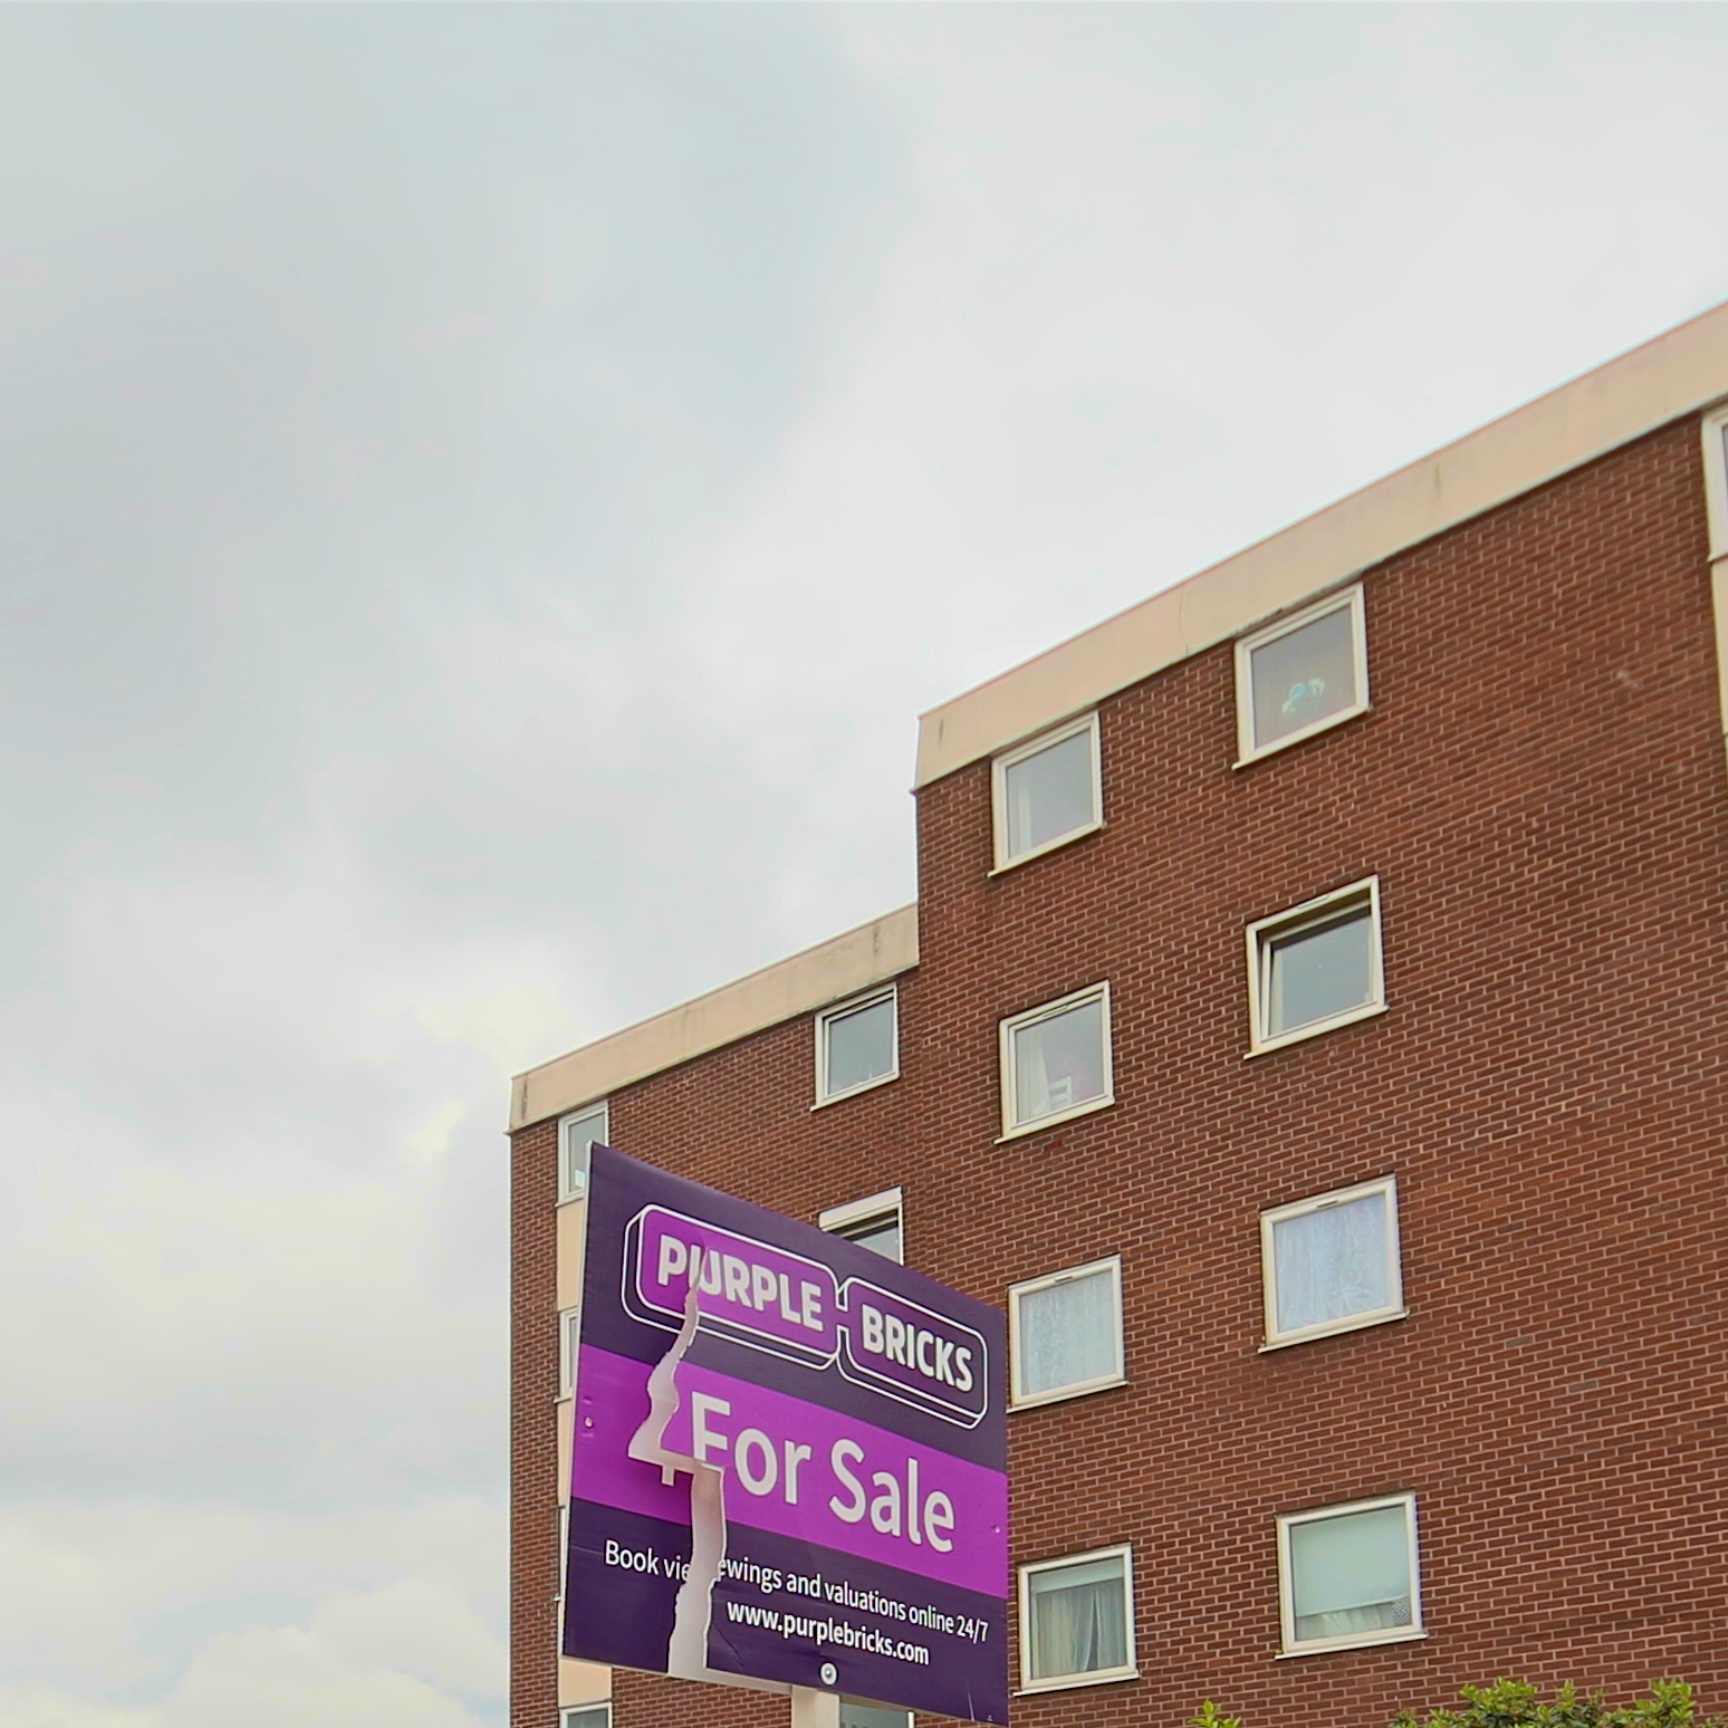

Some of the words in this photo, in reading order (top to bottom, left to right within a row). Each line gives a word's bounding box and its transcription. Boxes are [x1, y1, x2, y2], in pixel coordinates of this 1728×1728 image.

[658, 1234, 824, 1332] PURPLE
[862, 1304, 972, 1392] BRICKS
[691, 1391, 812, 1505] For
[828, 1438, 955, 1553] Sale
[605, 1540, 659, 1575] Book
[786, 1573, 821, 1598] and
[824, 1581, 907, 1621] valuations
[908, 1605, 955, 1634] online
[956, 1615, 989, 1644] 24/7
[727, 1602, 929, 1665] www.purplebricks.com
